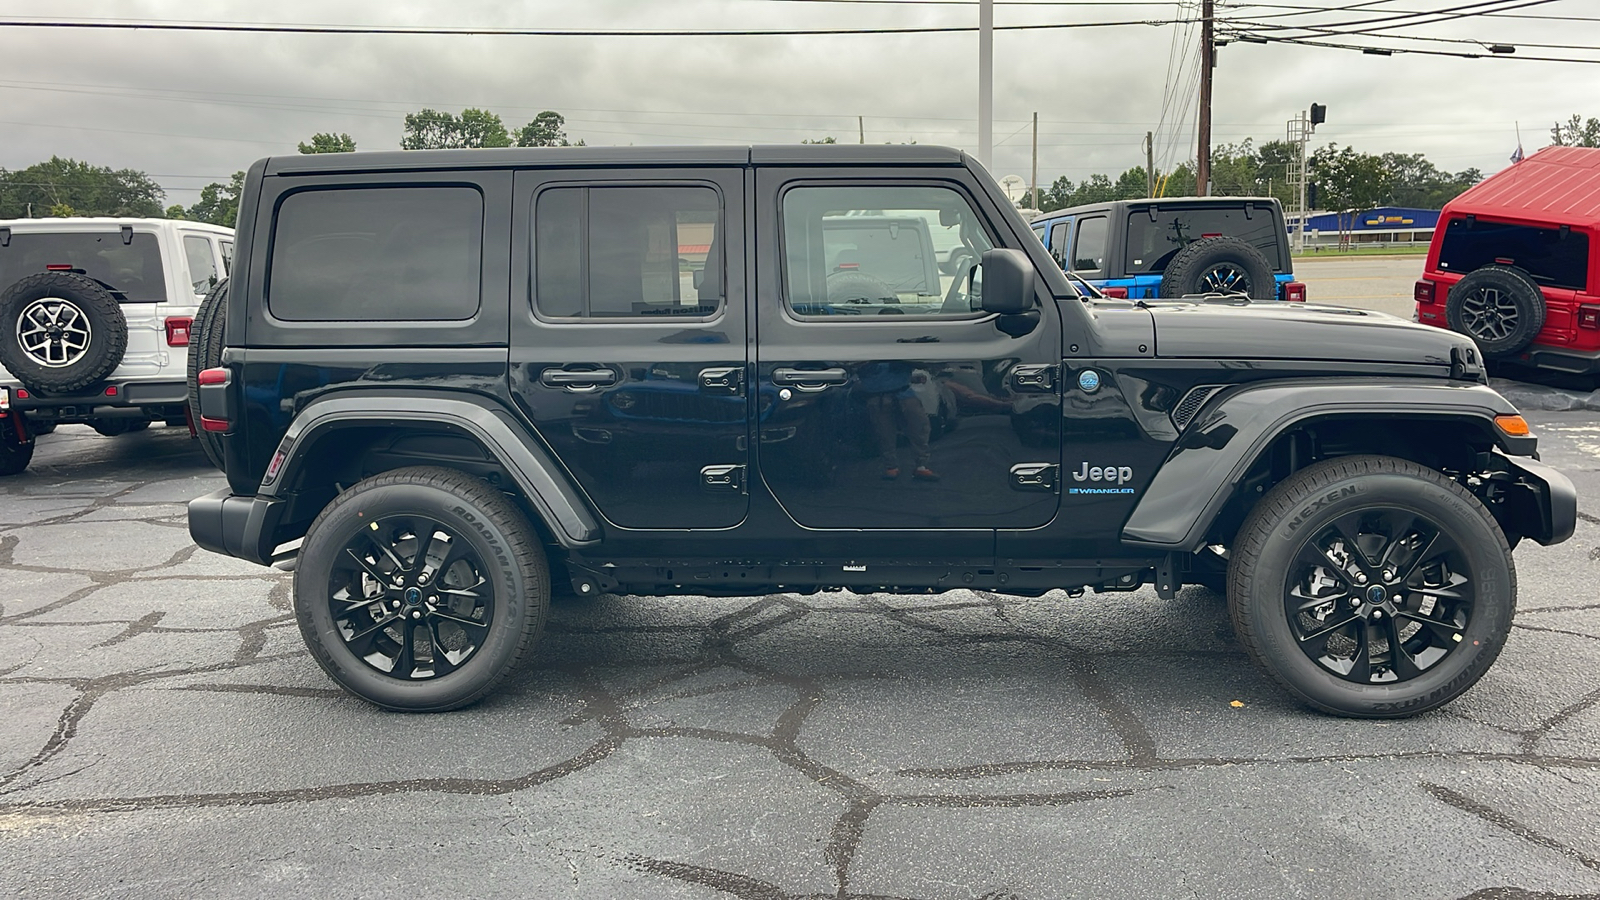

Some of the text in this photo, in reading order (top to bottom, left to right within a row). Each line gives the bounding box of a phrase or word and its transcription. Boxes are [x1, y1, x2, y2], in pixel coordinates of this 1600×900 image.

[1072, 461, 1132, 485] Jeep
[1288, 485, 1356, 532] NEXEN
[452, 505, 509, 568] ROADIAN
